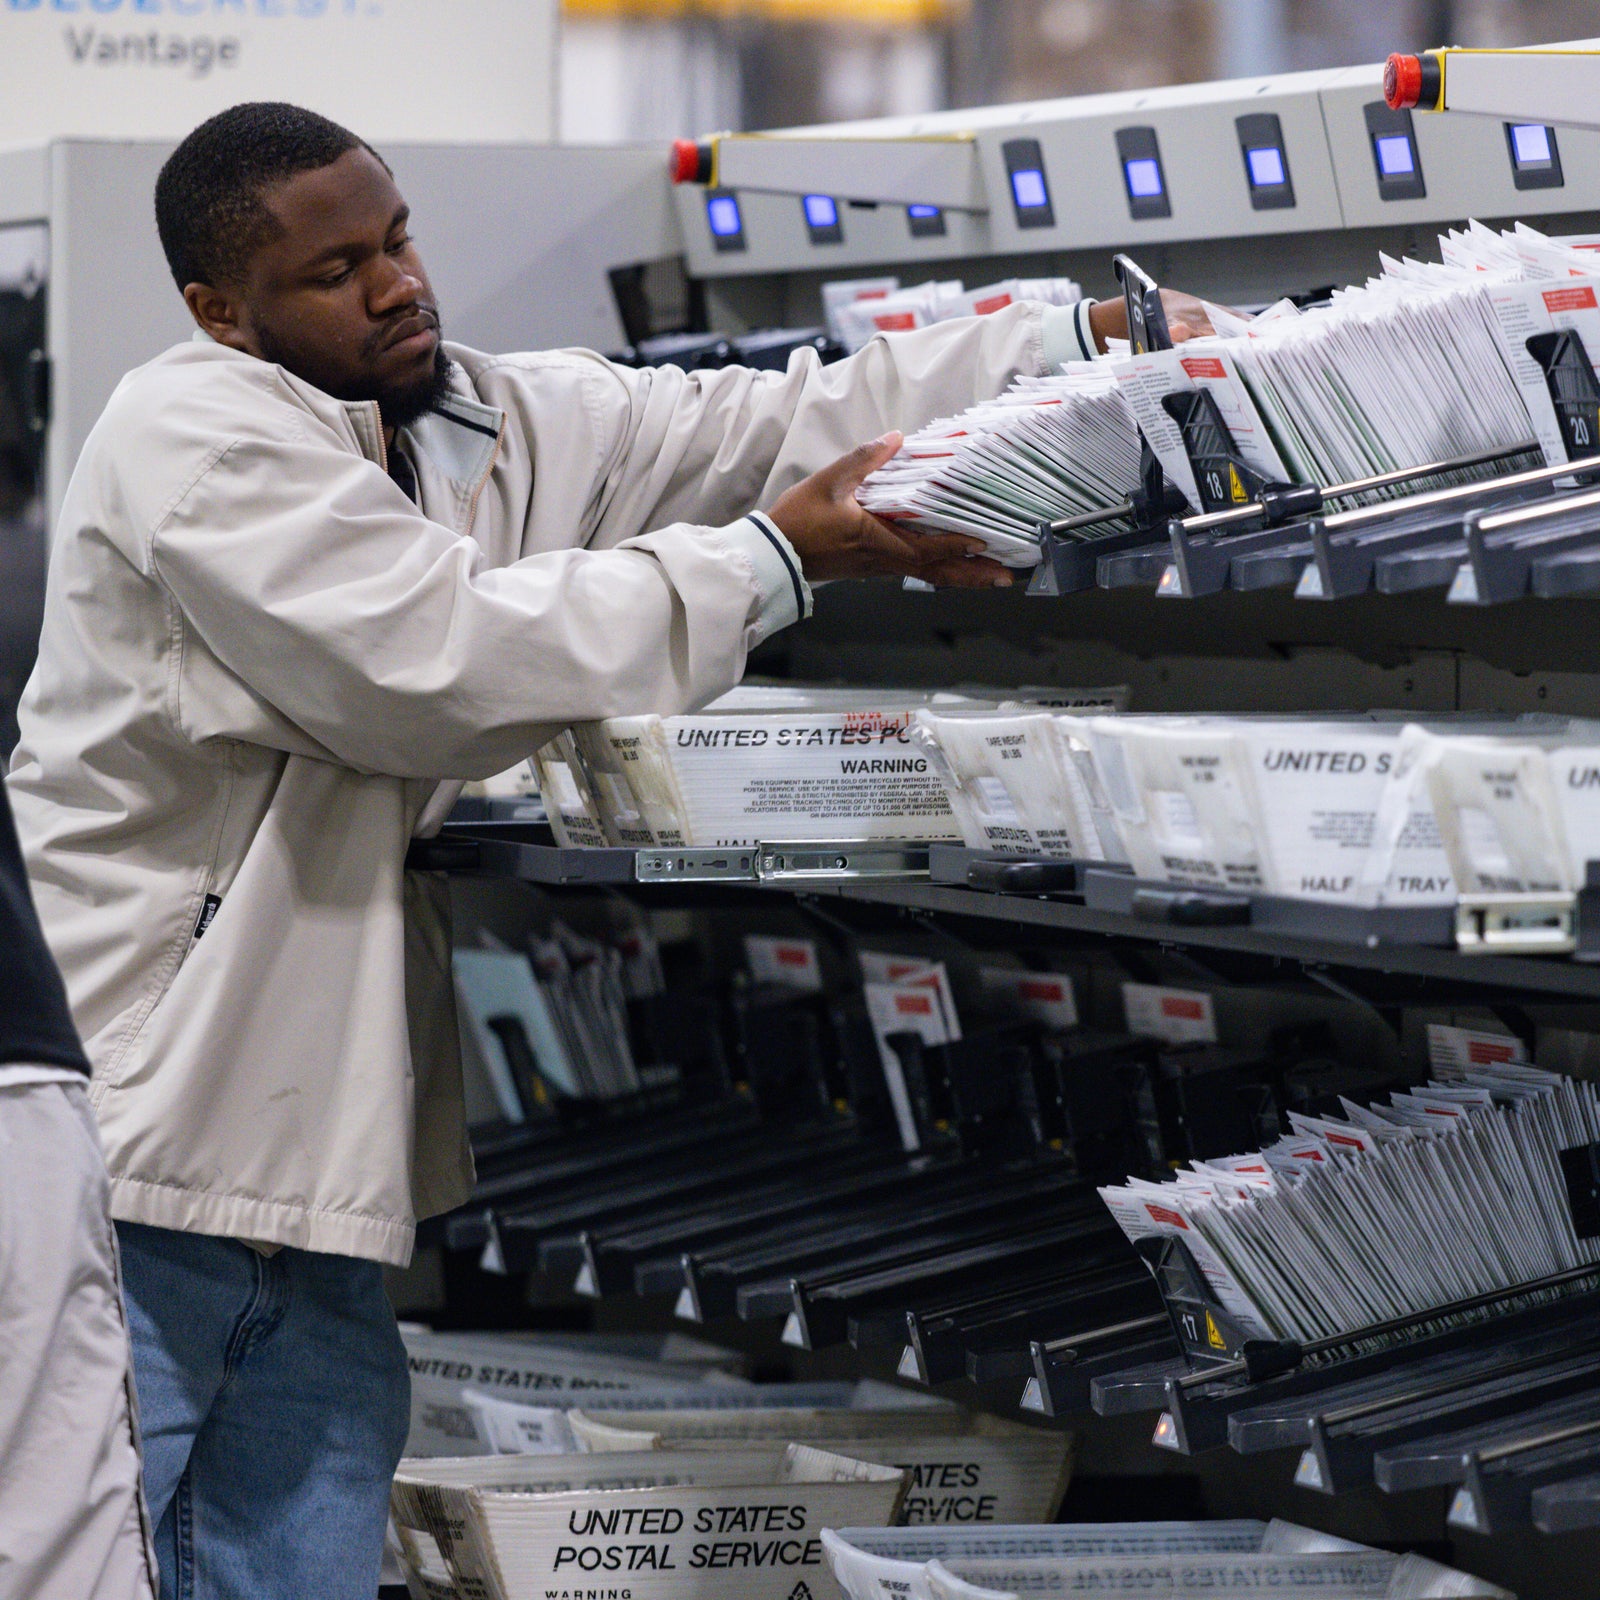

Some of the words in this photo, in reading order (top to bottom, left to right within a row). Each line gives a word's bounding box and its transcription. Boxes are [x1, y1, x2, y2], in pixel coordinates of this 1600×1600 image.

[65, 25, 240, 76] Vantage
[1570, 416, 1589, 445] 20
[1206, 472, 1224, 499] 18
[677, 729, 769, 747] UNITED
[776, 727, 873, 746] STATES
[841, 758, 928, 774] WARNING
[1263, 748, 1367, 774] UNITED
[1300, 875, 1354, 893] HALF
[1399, 875, 1451, 893] TRAY
[1182, 1313, 1199, 1342] 17
[408, 1357, 473, 1381] NITED
[477, 1365, 566, 1391] STATES
[568, 1508, 684, 1535] UNITED
[693, 1506, 807, 1533] STATES
[905, 1496, 998, 1523] RVICE
[553, 1545, 676, 1572] POSTAL
[688, 1539, 822, 1569] SERVICE
[545, 1589, 632, 1599] WARNING
